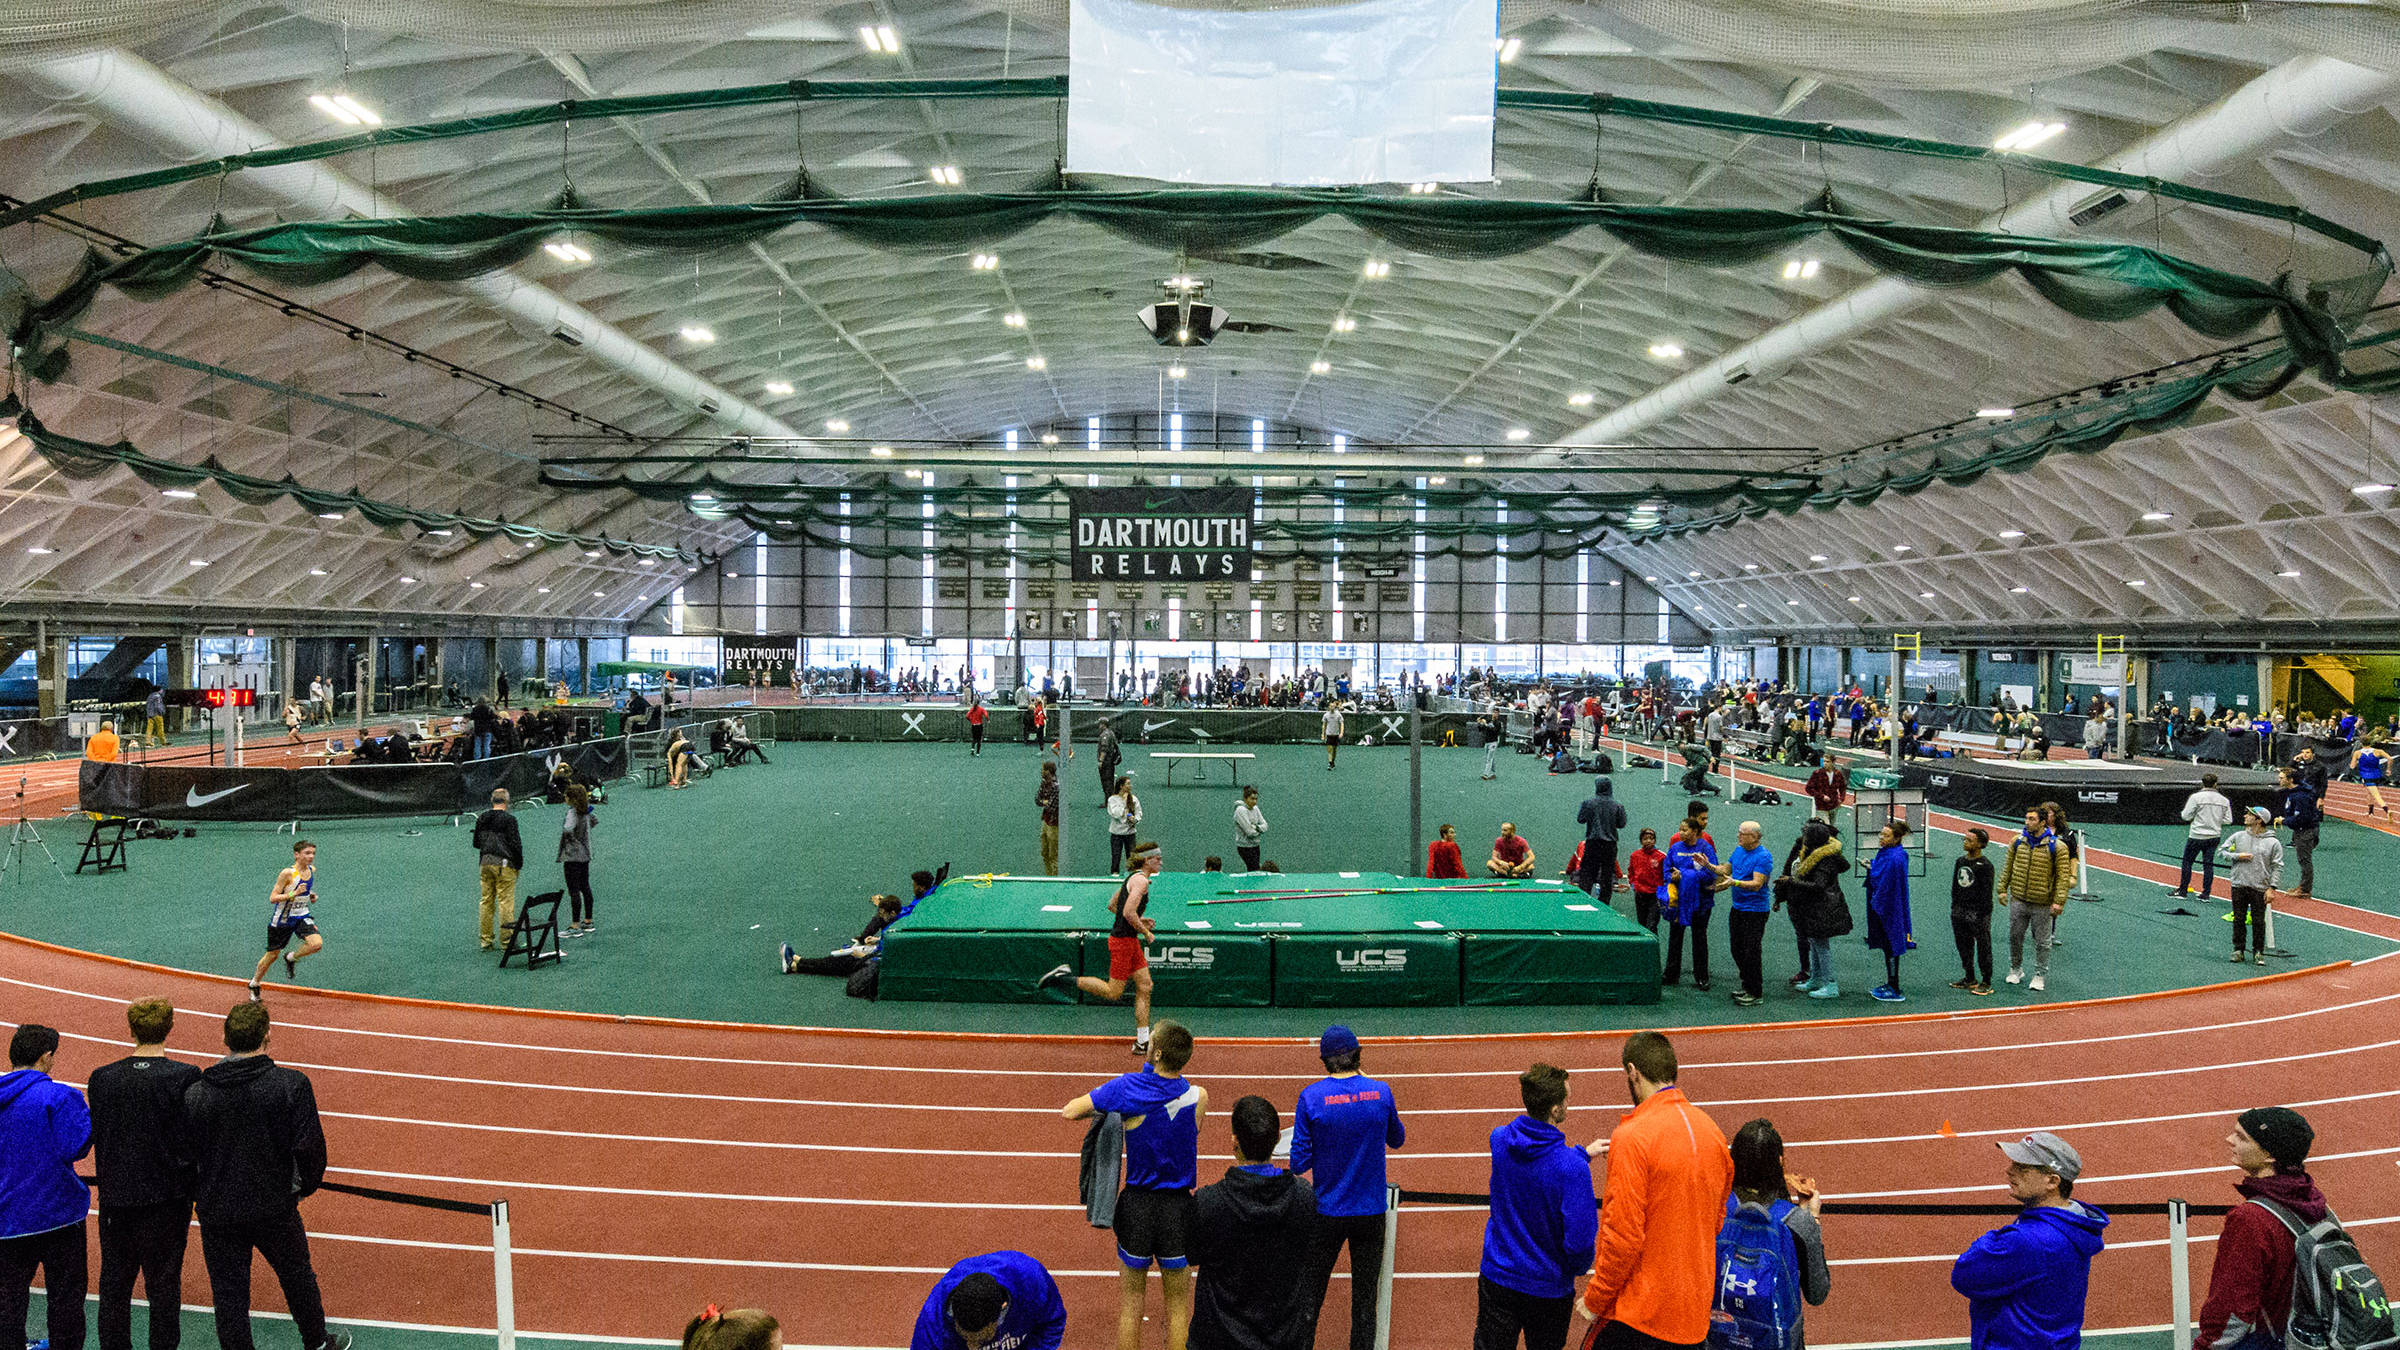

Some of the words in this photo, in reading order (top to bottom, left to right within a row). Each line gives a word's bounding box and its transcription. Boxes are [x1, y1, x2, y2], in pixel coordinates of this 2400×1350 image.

[1078, 518, 1247, 547] DARTMOUTH
[1091, 554, 1234, 575] RELAYS
[726, 647, 795, 660] DARTMOUTH
[726, 660, 783, 670] RELAYS
[1930, 775, 1949, 785] UCS
[2078, 791, 2119, 800] UCS
[1144, 946, 1215, 963] UCS
[1336, 949, 1407, 966] UCS
